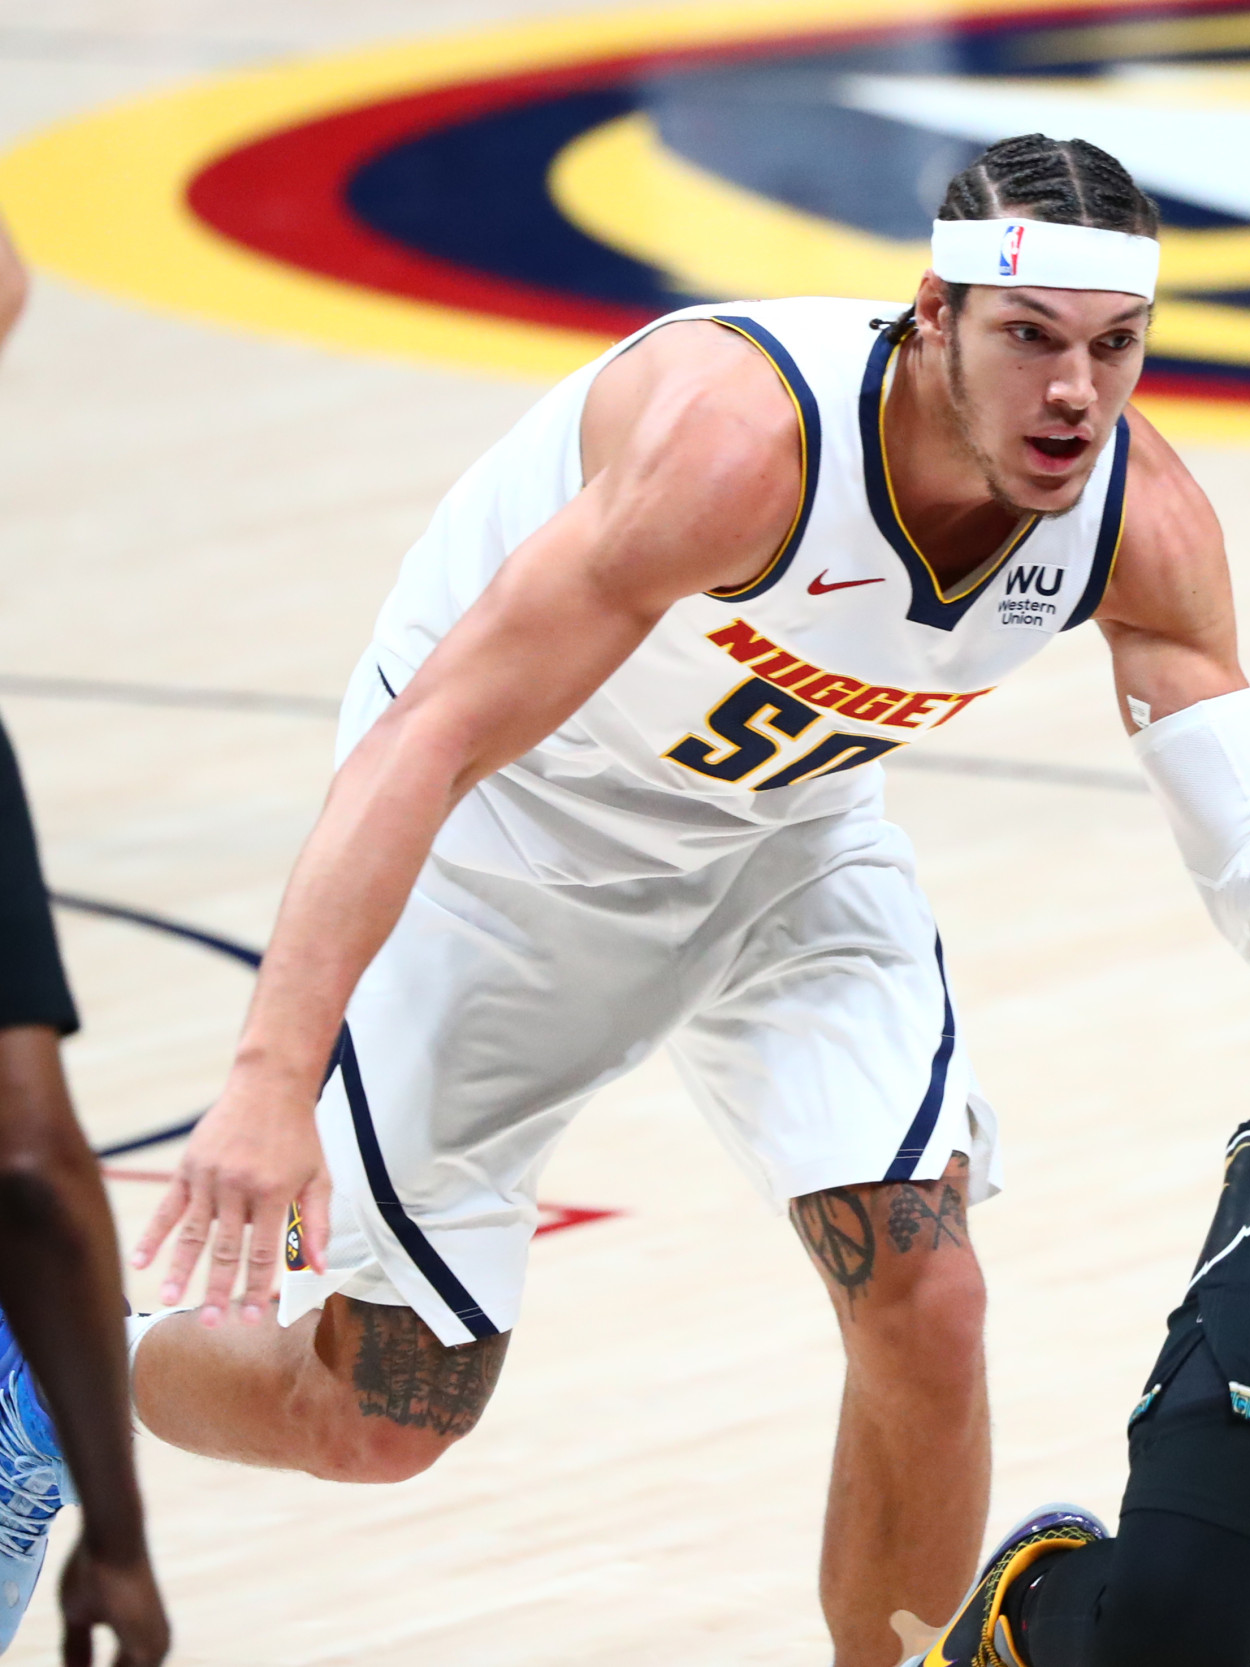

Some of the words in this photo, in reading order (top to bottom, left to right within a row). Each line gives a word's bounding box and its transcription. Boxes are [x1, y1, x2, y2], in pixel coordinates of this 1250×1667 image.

[1006, 565, 1064, 596] WU
[998, 599, 1056, 615] Western
[1002, 611, 1043, 626] Union
